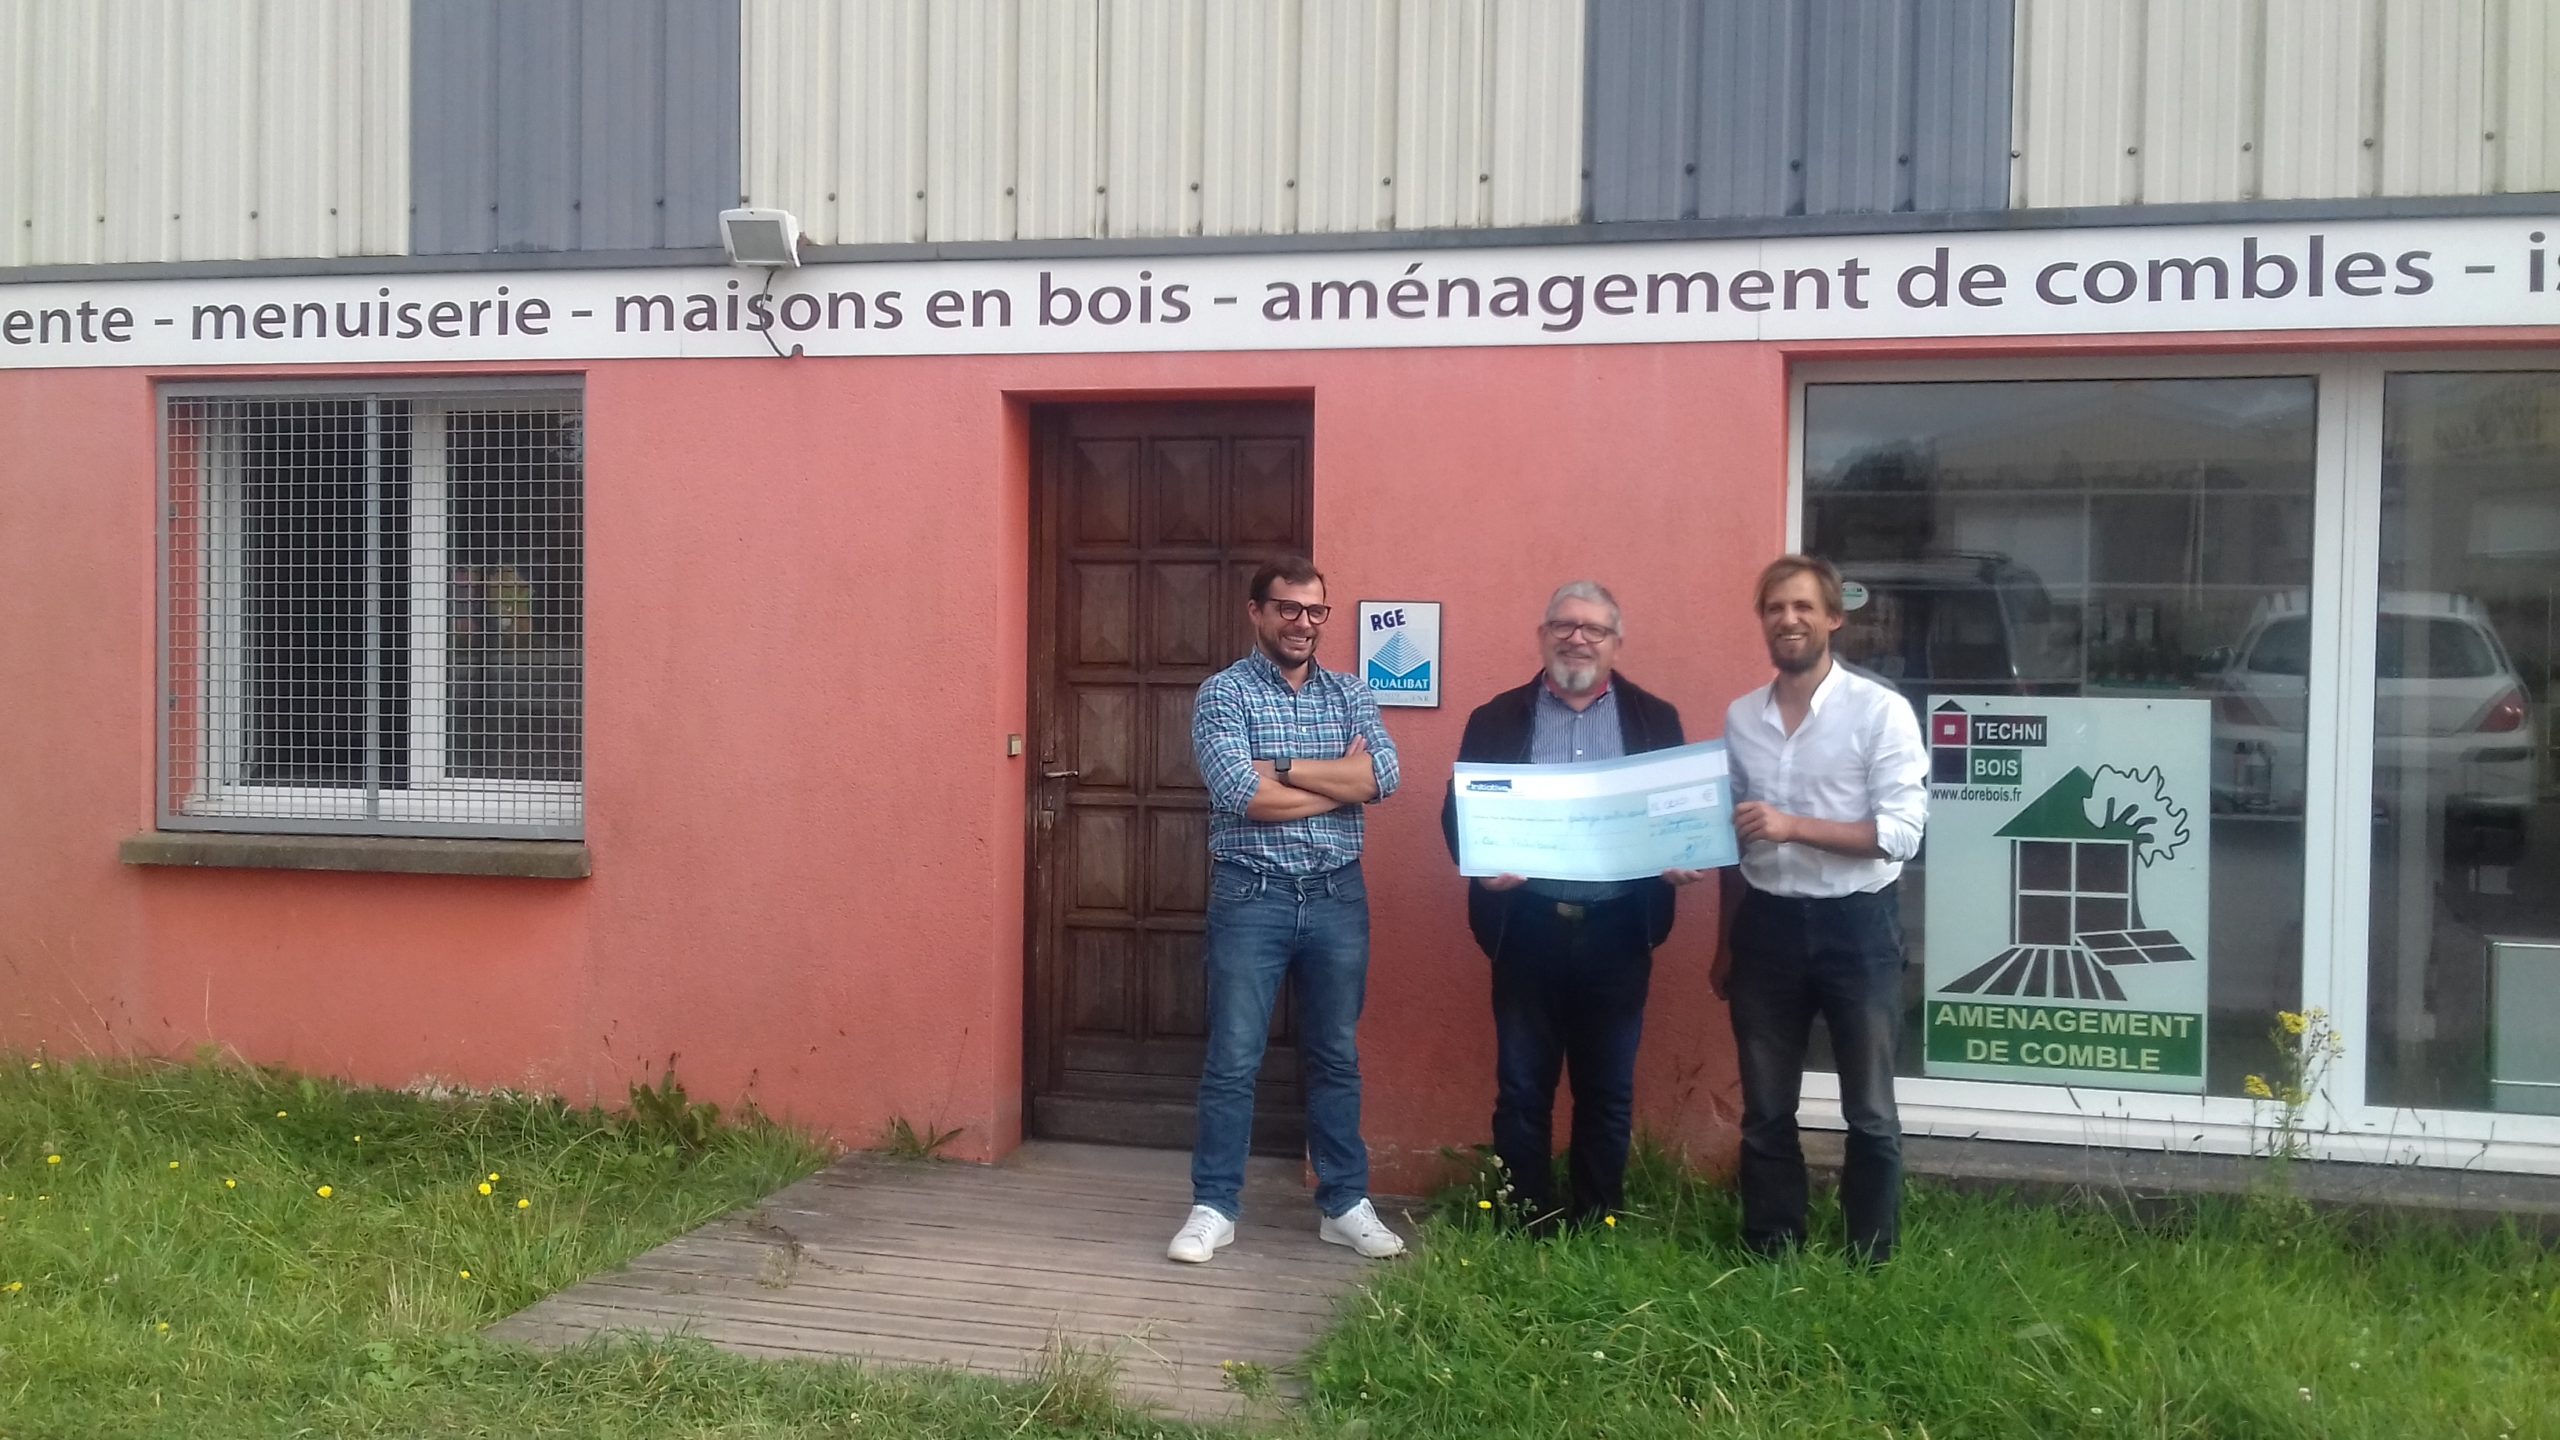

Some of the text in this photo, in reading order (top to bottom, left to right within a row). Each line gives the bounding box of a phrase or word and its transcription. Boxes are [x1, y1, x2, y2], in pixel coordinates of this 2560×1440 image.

[192, 286, 551, 340] menuiserie
[615, 279, 903, 333] maisons
[926, 290, 1011, 329] en
[1039, 270, 1191, 326] bois
[1262, 262, 1870, 332] aménagement
[1897, 247, 2007, 309] de
[2035, 234, 2434, 306] combles
[1370, 608, 1406, 632] RGE
[1369, 678, 1428, 689] QUALIBAT
[1975, 723, 2042, 740] TECHNI
[1975, 759, 2018, 776] BOIS
[1931, 786, 2022, 802] www.dorebois.fr
[1934, 1004, 2195, 1038] AMENAGEMENT
[1966, 1039, 2161, 1072] DE COMBLE
